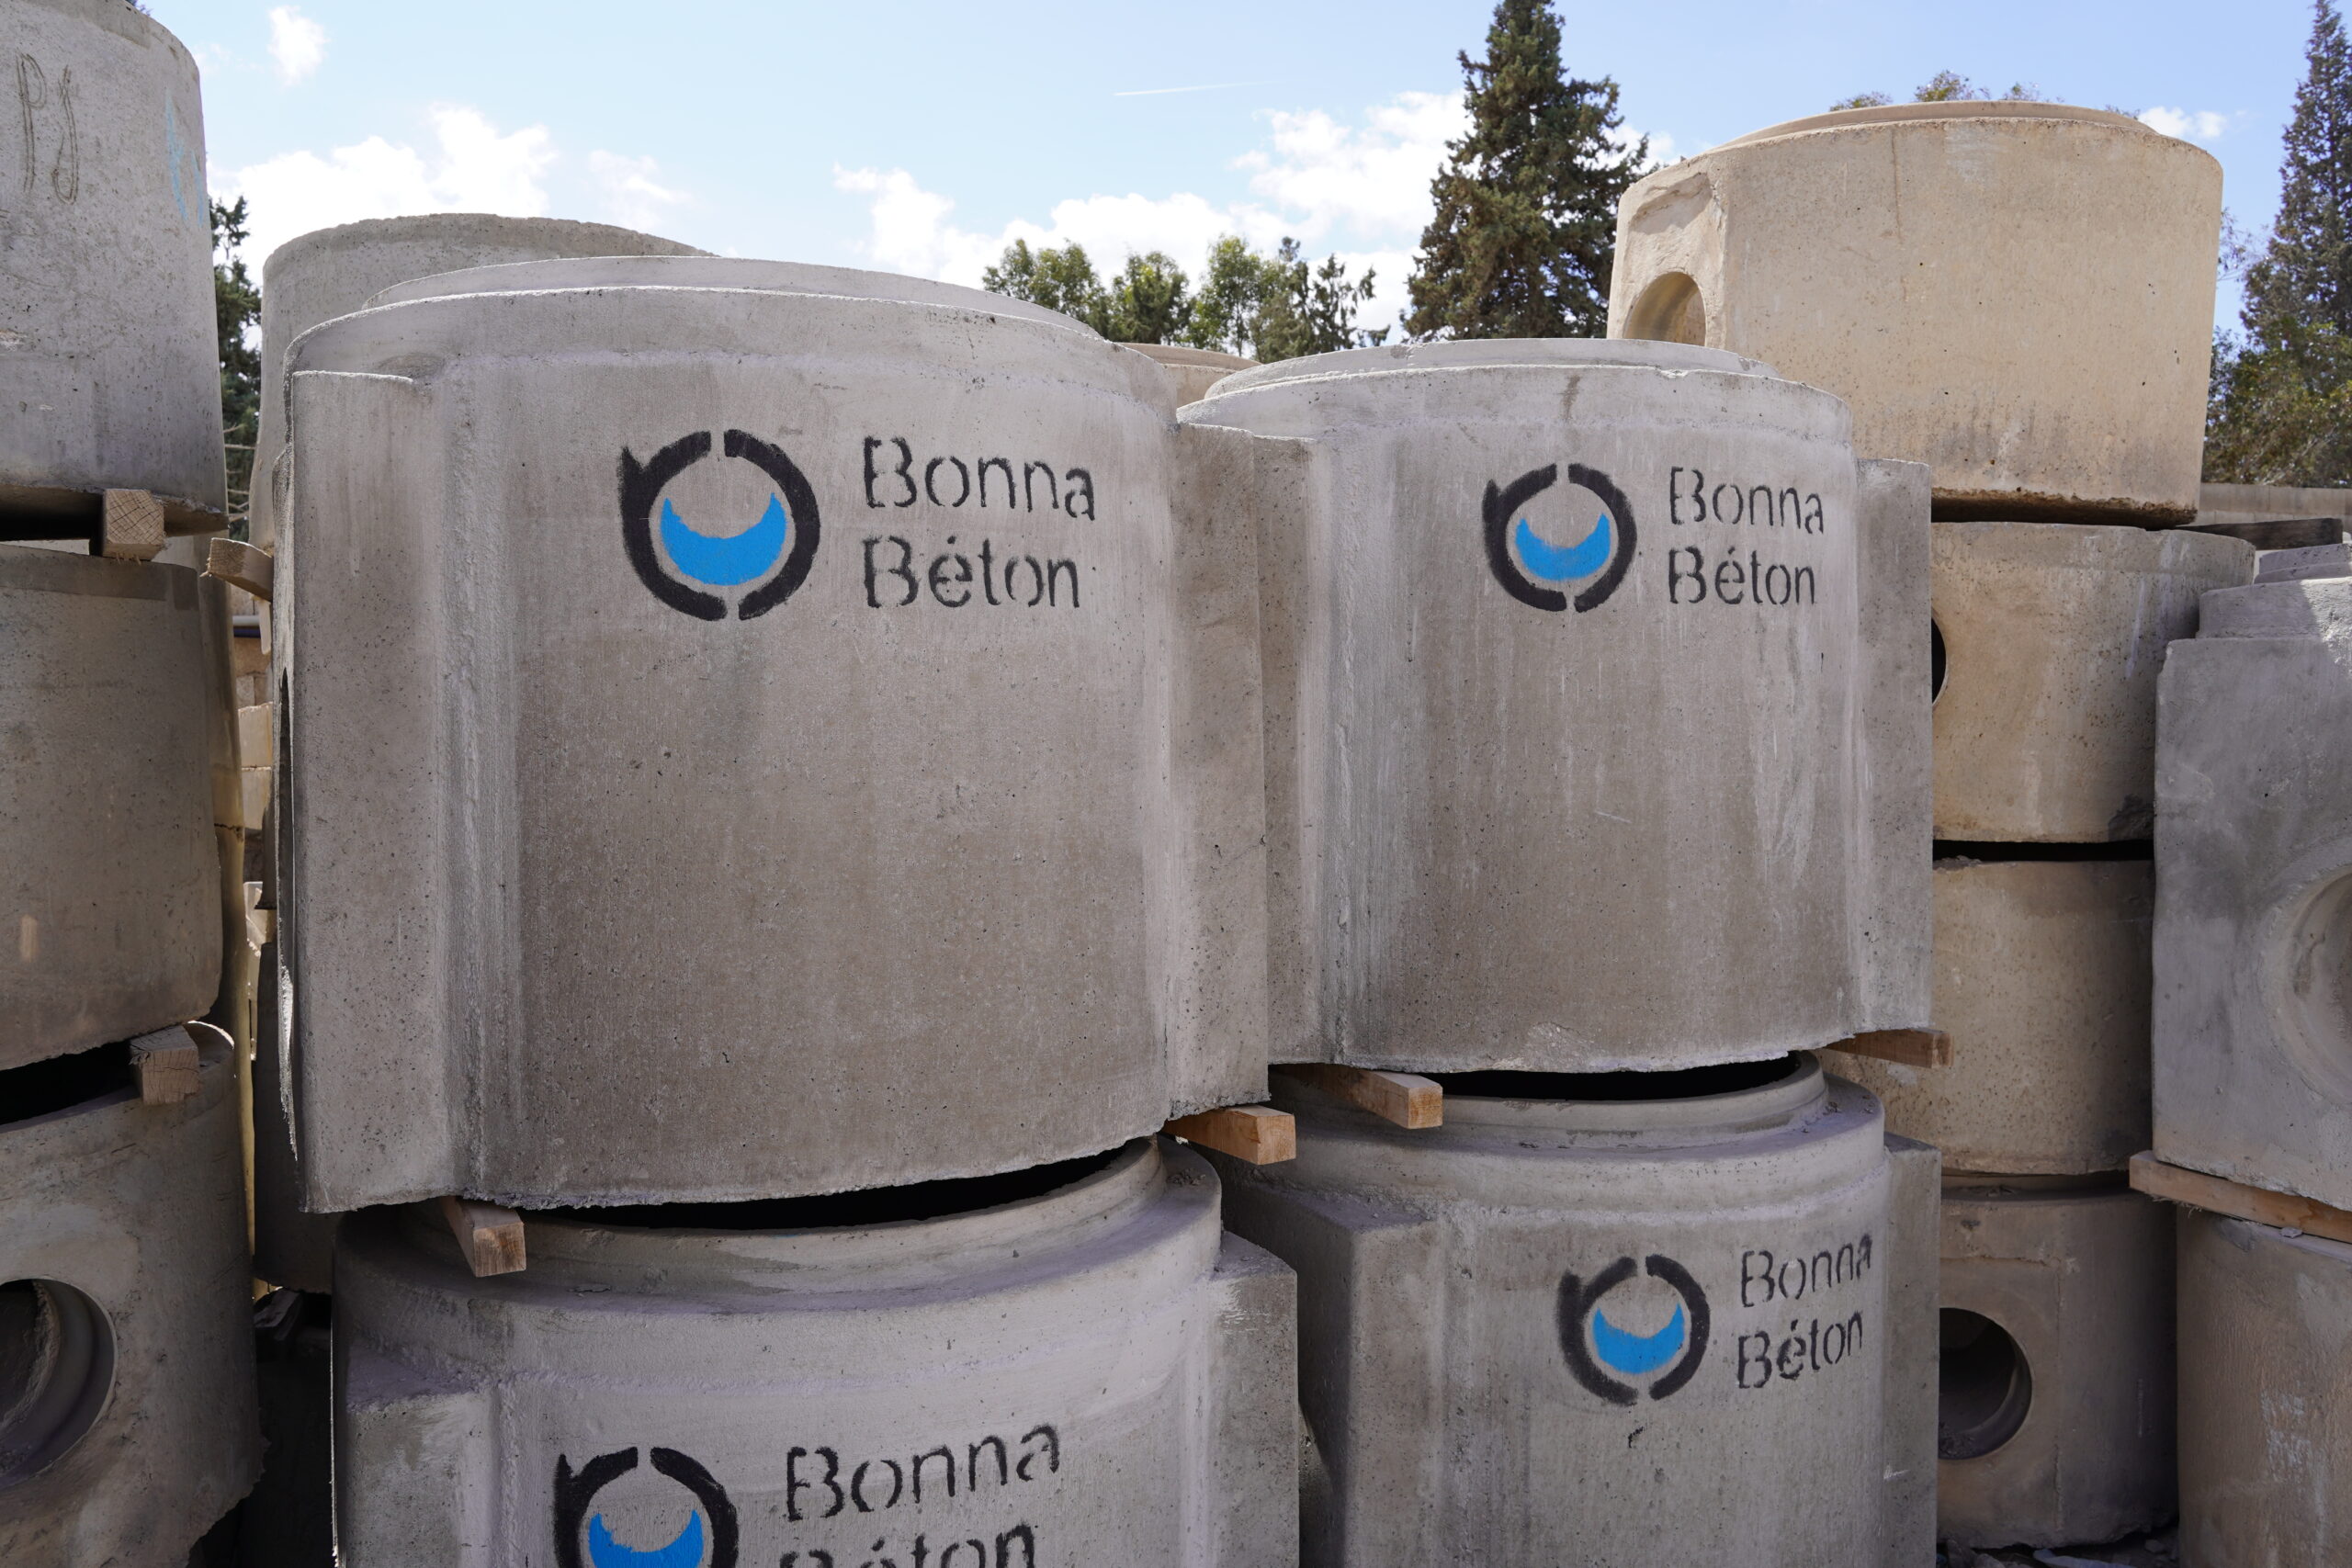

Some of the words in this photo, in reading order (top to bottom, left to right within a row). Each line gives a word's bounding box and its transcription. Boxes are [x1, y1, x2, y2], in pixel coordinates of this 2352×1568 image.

[863, 435, 1096, 522] Bonna
[1669, 466, 1825, 535] Bonna
[862, 534, 1080, 609] Béton
[1668, 546, 1816, 605] Béton
[1740, 1232, 1873, 1308] Bonna
[1736, 1308, 1864, 1390] Béton
[785, 1422, 1061, 1523] Bonna
[778, 1521, 1036, 1568] ton
